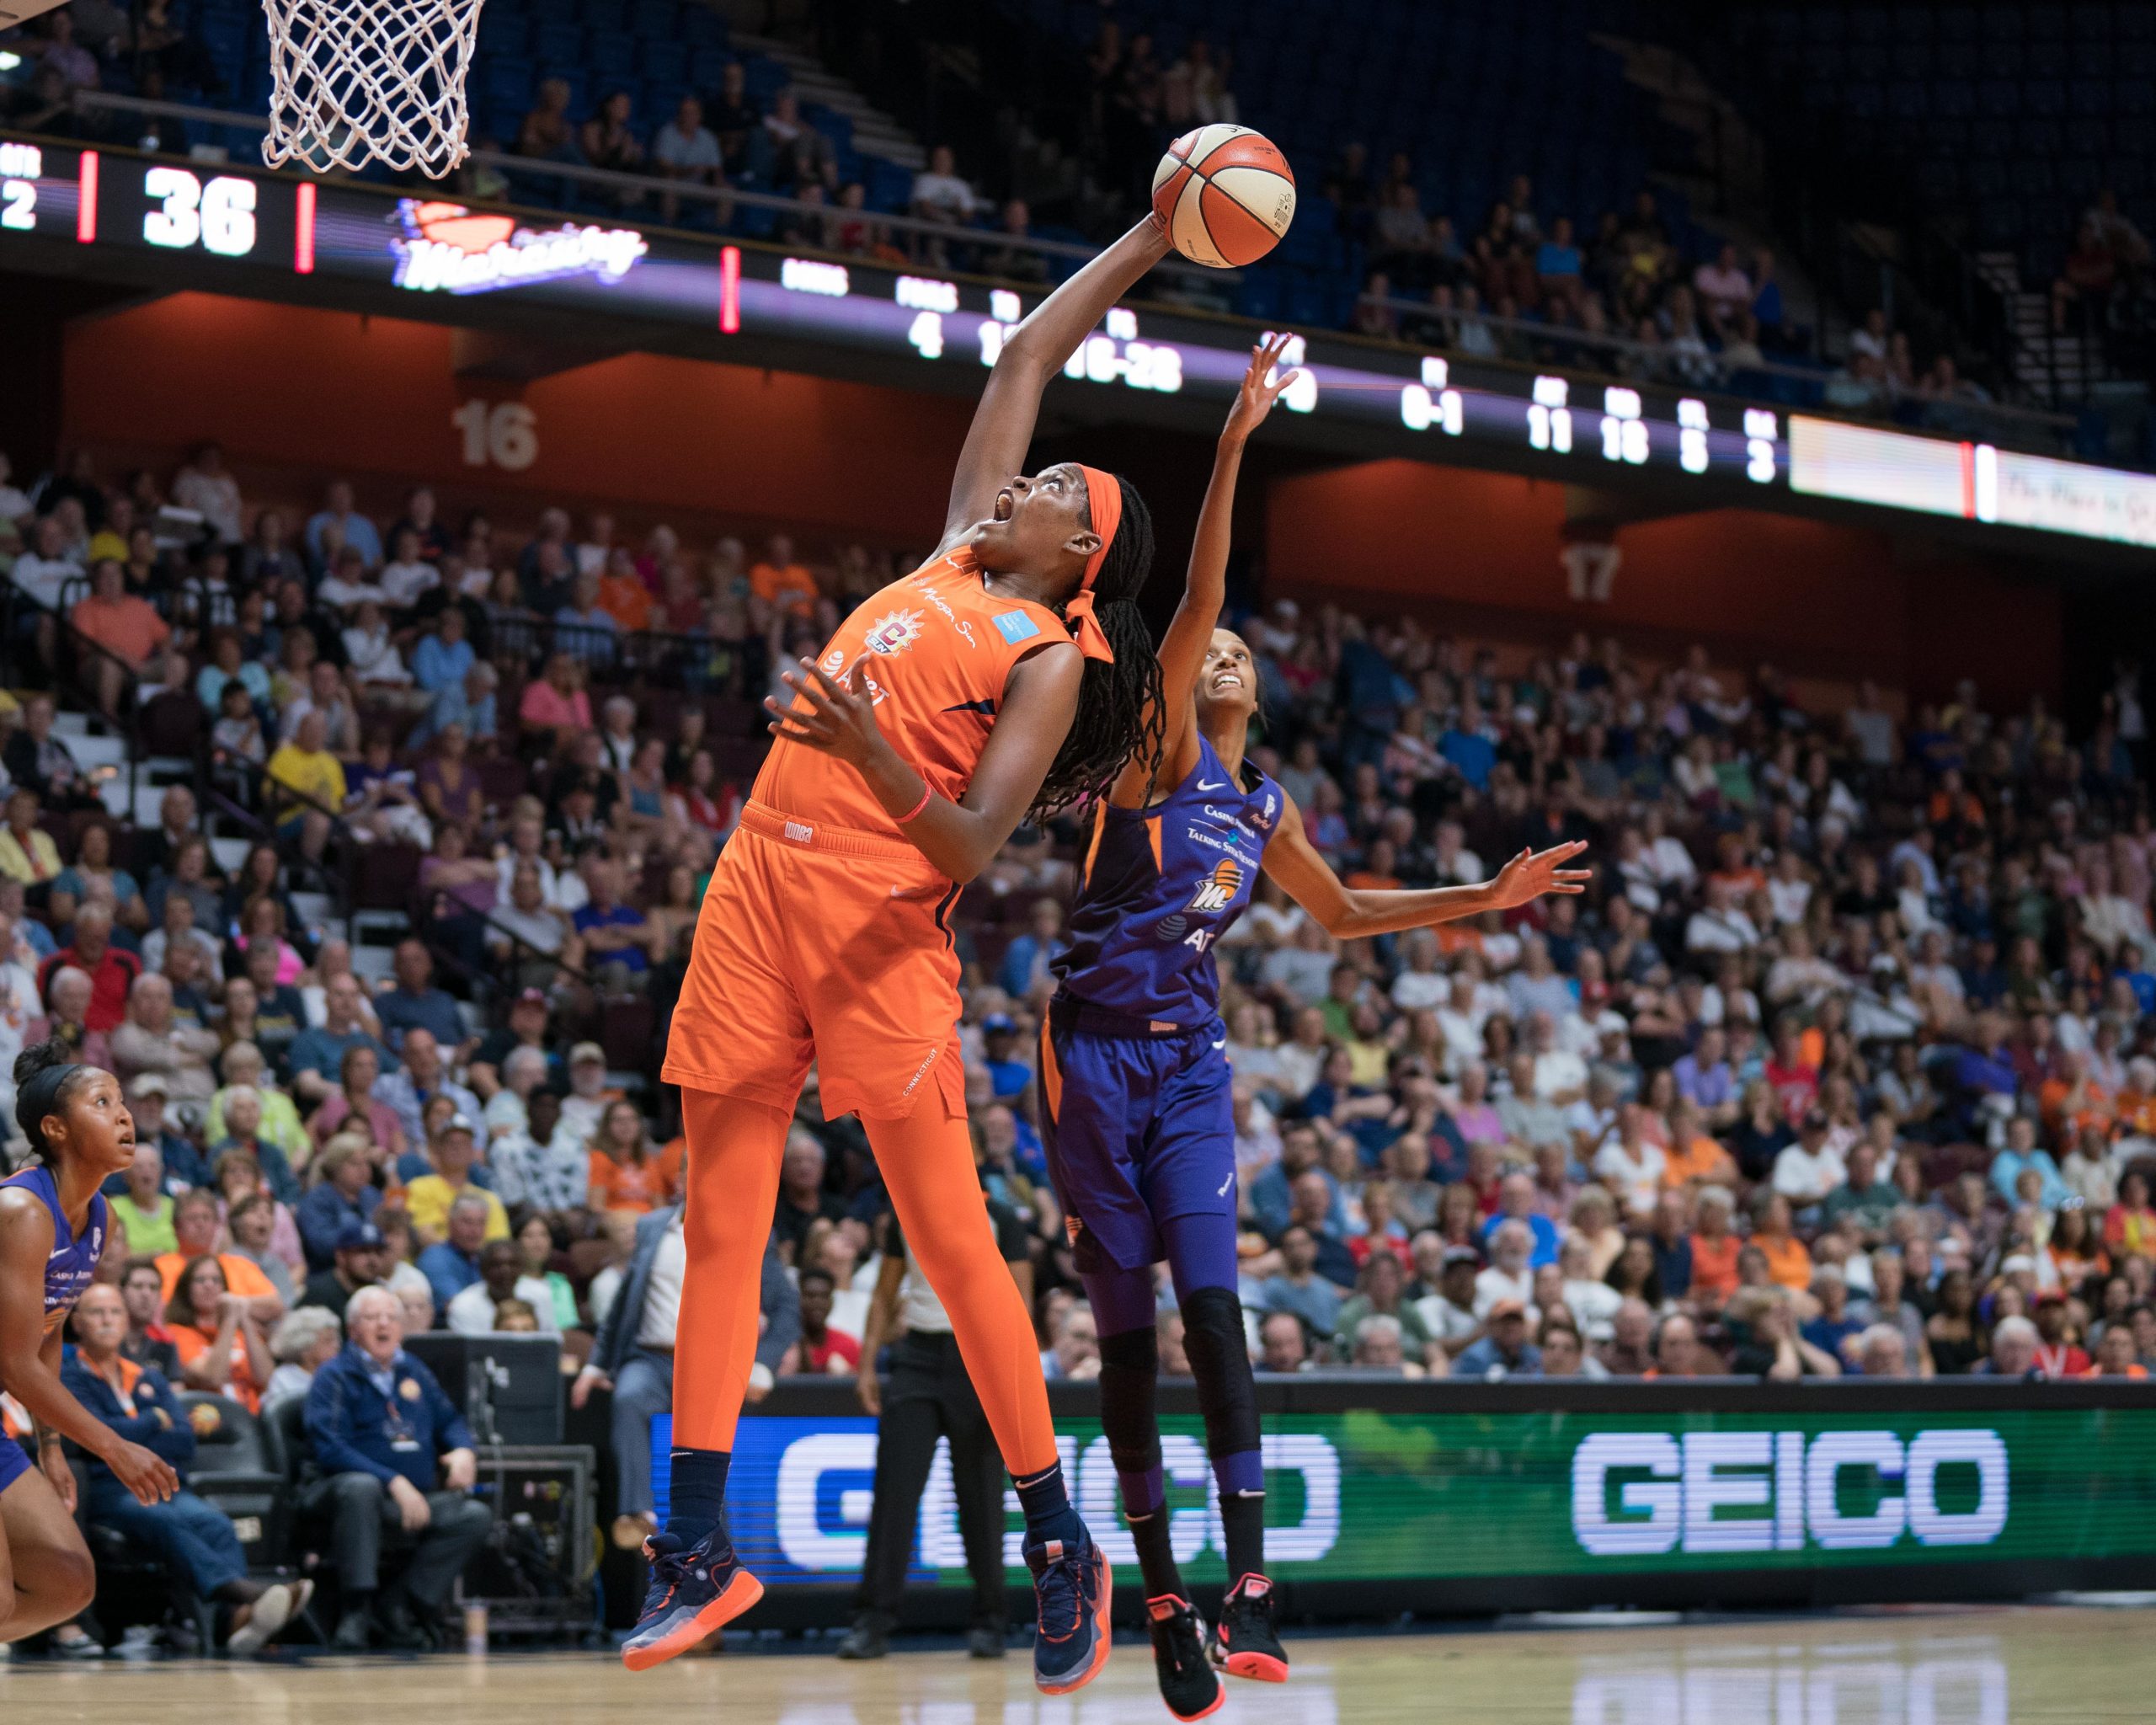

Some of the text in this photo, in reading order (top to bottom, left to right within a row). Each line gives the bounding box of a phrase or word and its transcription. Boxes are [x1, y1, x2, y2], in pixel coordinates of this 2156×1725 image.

[2, 179, 37, 230] 2
[143, 167, 256, 256] 36
[909, 311, 943, 359] 4
[452, 398, 538, 470] 16
[1560, 542, 1620, 601] 17
[867, 636, 888, 653] SUN
[954, 621, 976, 649] Sun
[835, 665, 890, 707] A&T
[903, 1048, 937, 1097] CONNECTICUT
[1572, 1429, 2009, 1556] GEICO
